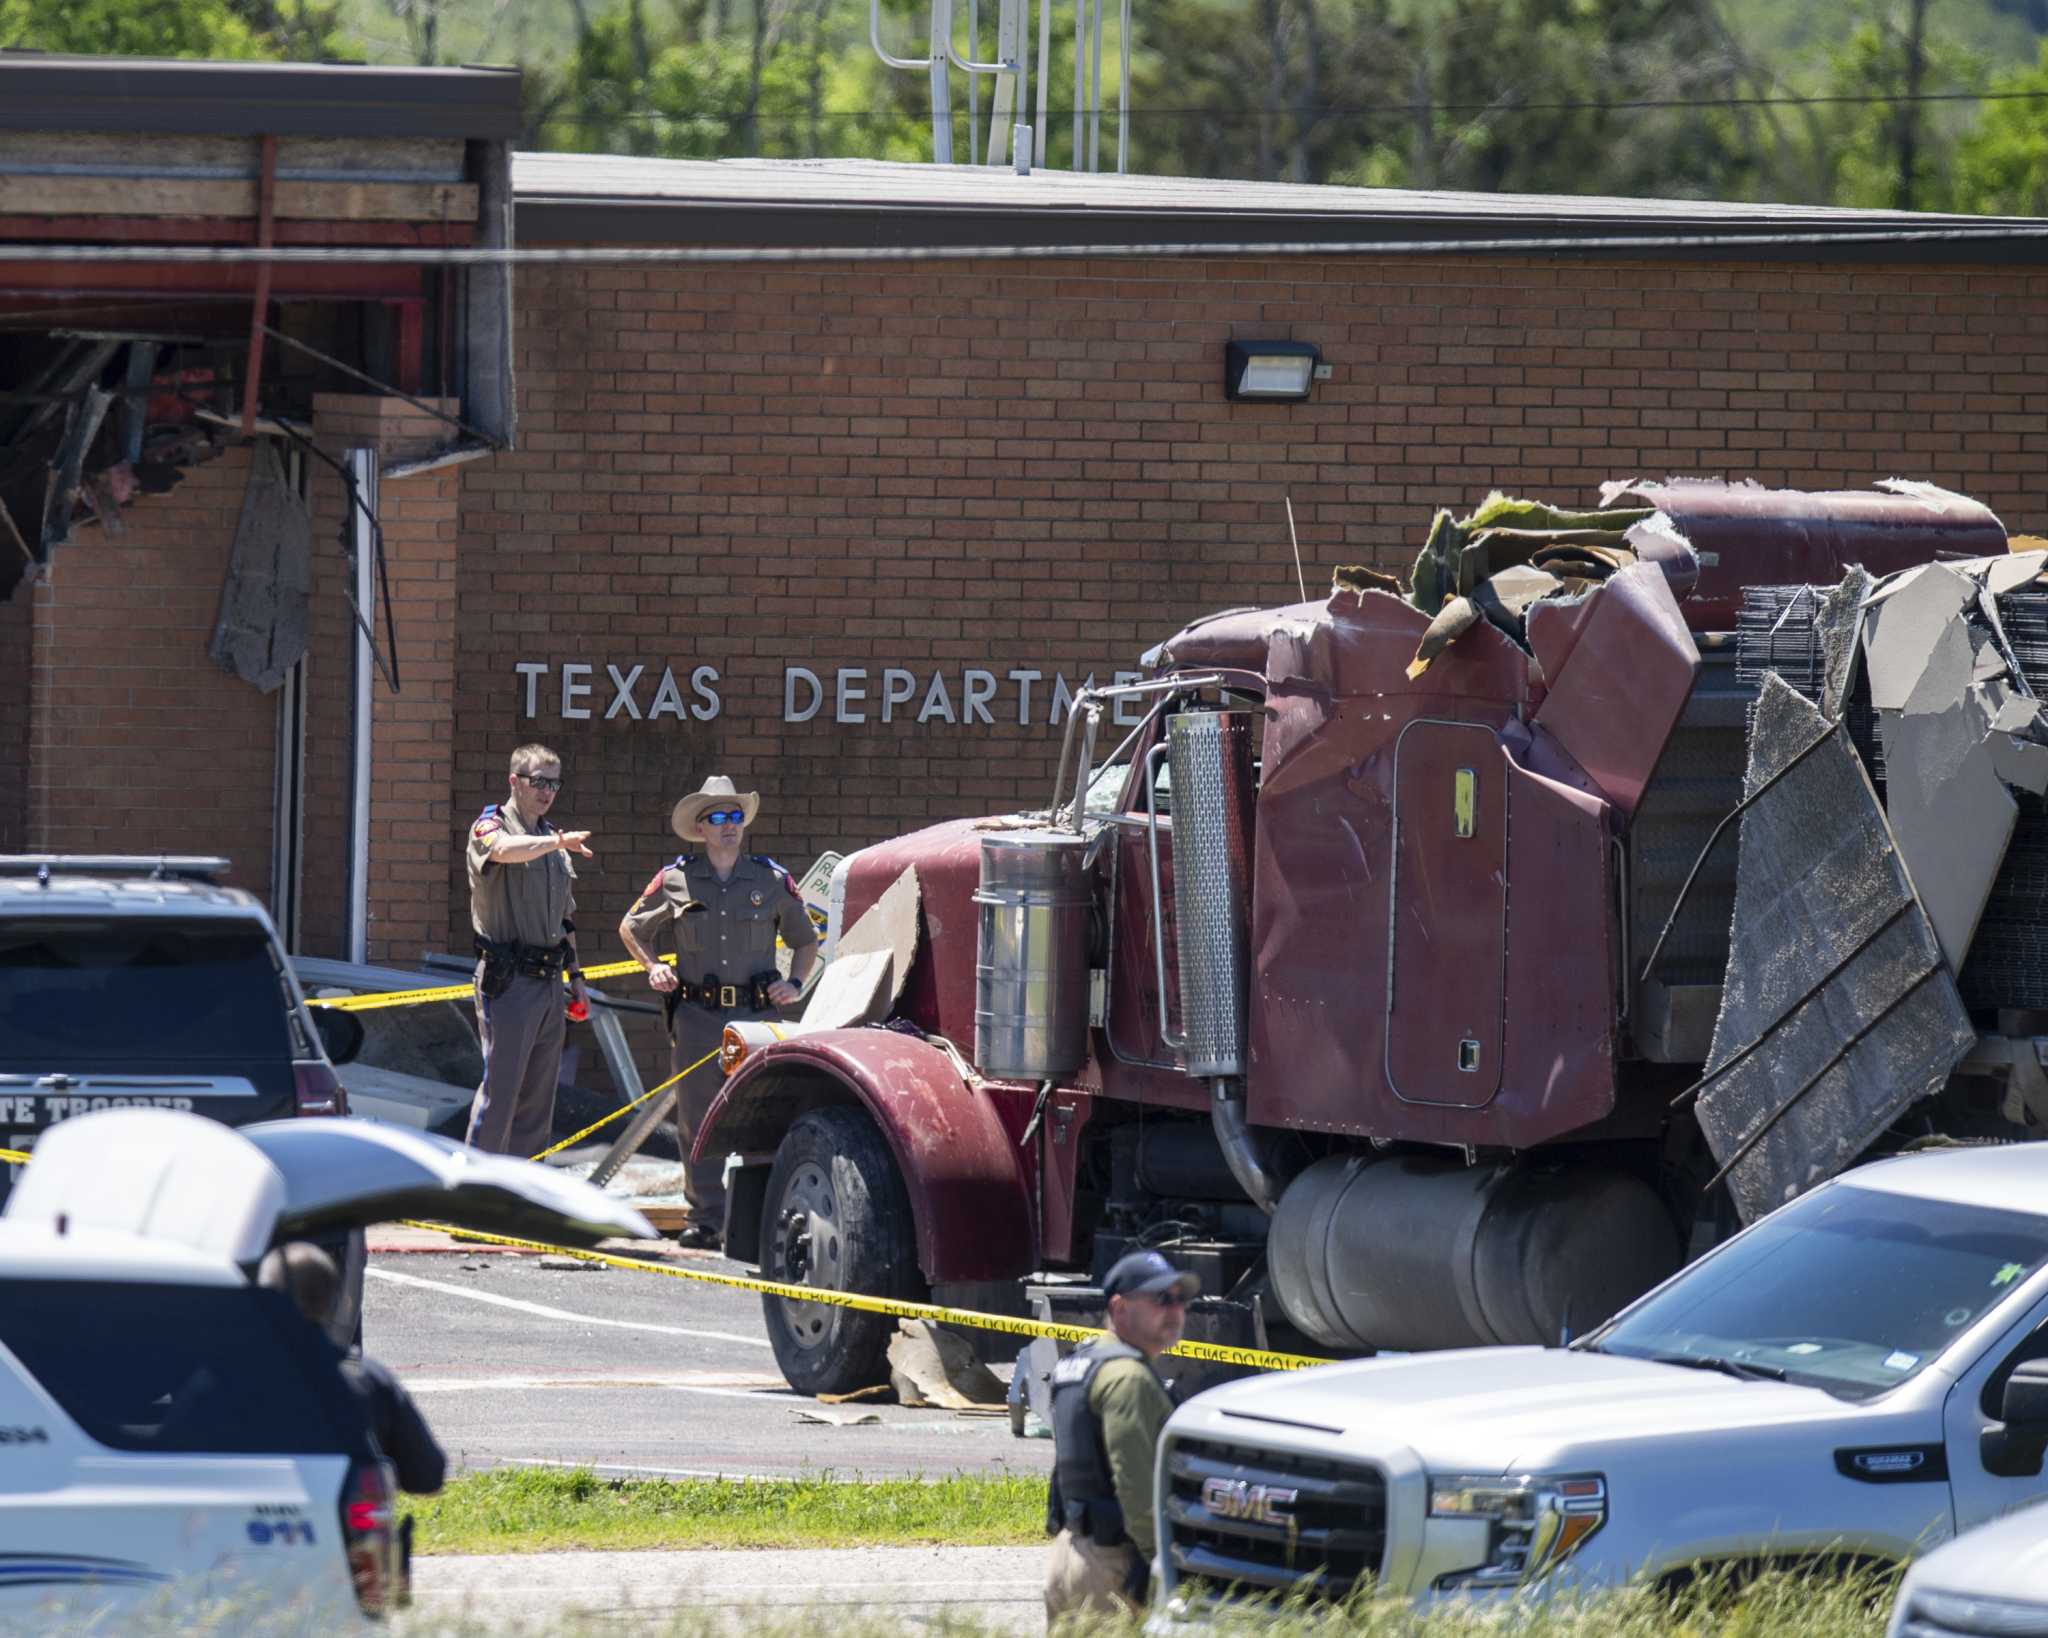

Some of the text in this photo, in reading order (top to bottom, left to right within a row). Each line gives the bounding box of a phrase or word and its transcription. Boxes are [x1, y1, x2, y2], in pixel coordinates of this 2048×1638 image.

[515, 662, 1230, 727] TEXAS DEPARTME
[1202, 1477, 1298, 1524] GMC
